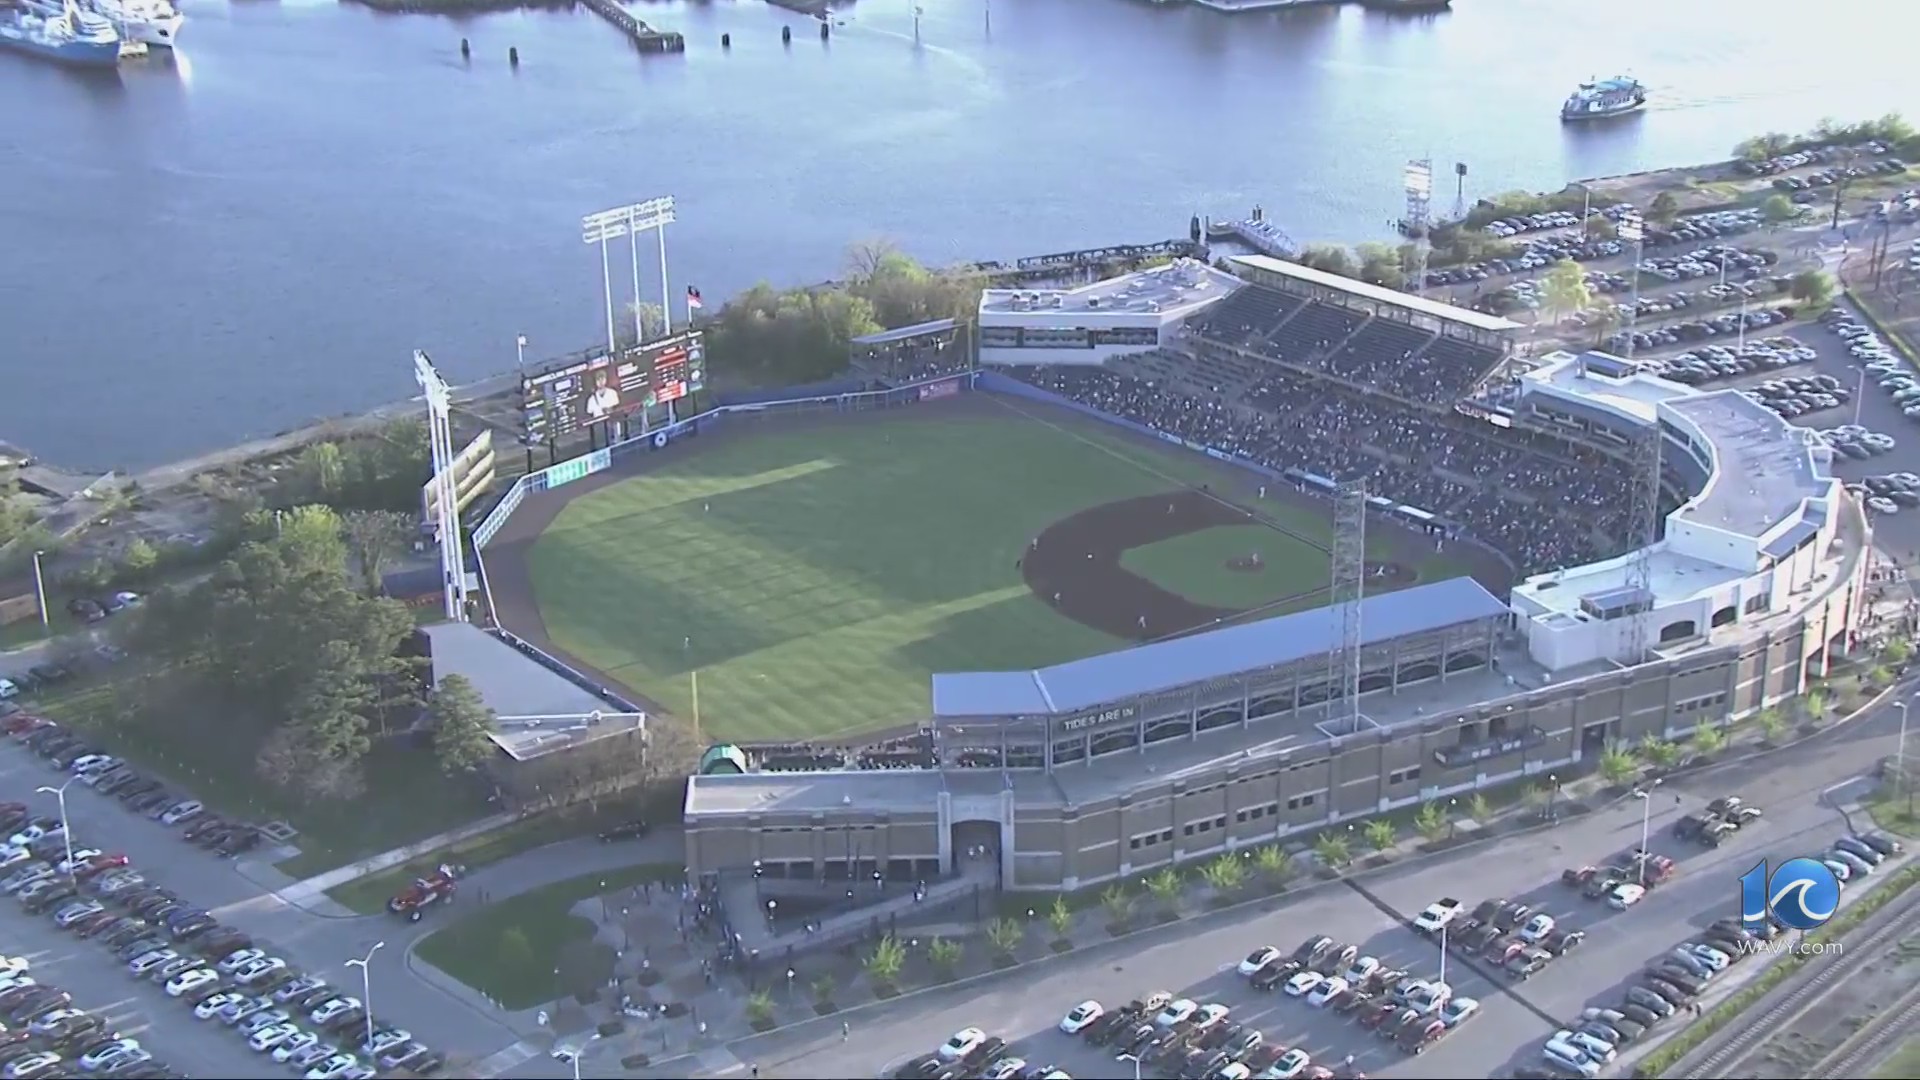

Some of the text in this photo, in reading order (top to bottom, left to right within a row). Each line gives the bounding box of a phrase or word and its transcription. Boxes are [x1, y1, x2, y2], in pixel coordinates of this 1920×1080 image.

[1064, 707, 1134, 731] TIDES ARE IN
